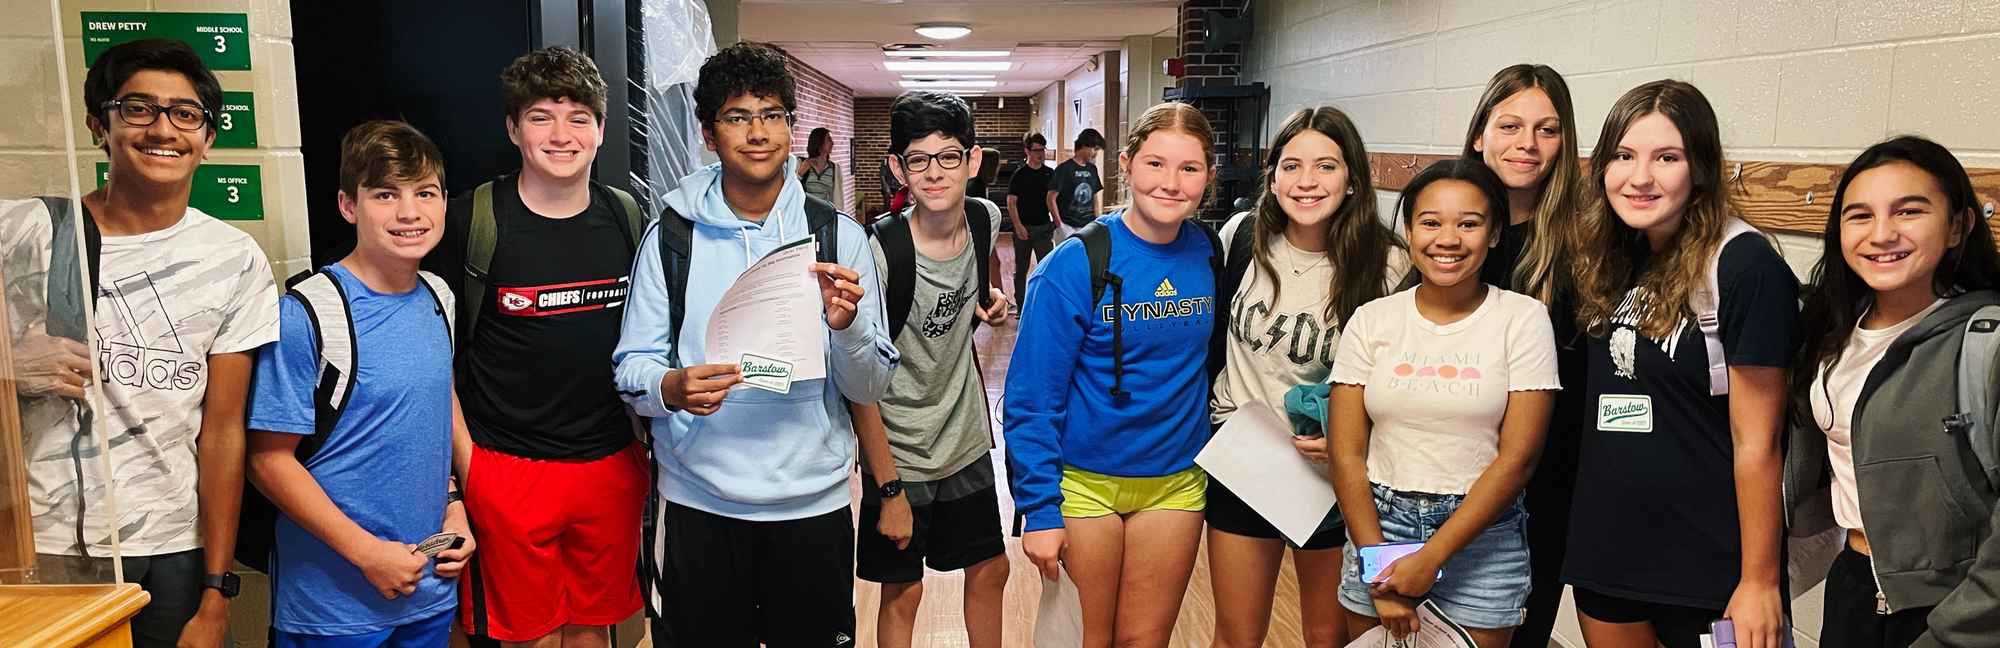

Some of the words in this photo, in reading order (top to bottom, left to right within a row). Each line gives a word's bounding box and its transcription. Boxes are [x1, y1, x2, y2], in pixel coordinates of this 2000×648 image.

[89, 22, 116, 31] DREW
[118, 22, 147, 31] PETTY
[219, 26, 244, 34] SCHOOL
[214, 35, 227, 53] 3
[226, 104, 250, 112] SCHOOL
[220, 112, 233, 130] 3
[227, 177, 248, 185] OFFICE
[227, 186, 240, 203] 3
[538, 289, 581, 308] CHIEFS
[1102, 296, 1213, 322] DYNASTY
[99, 339, 201, 390] idas
